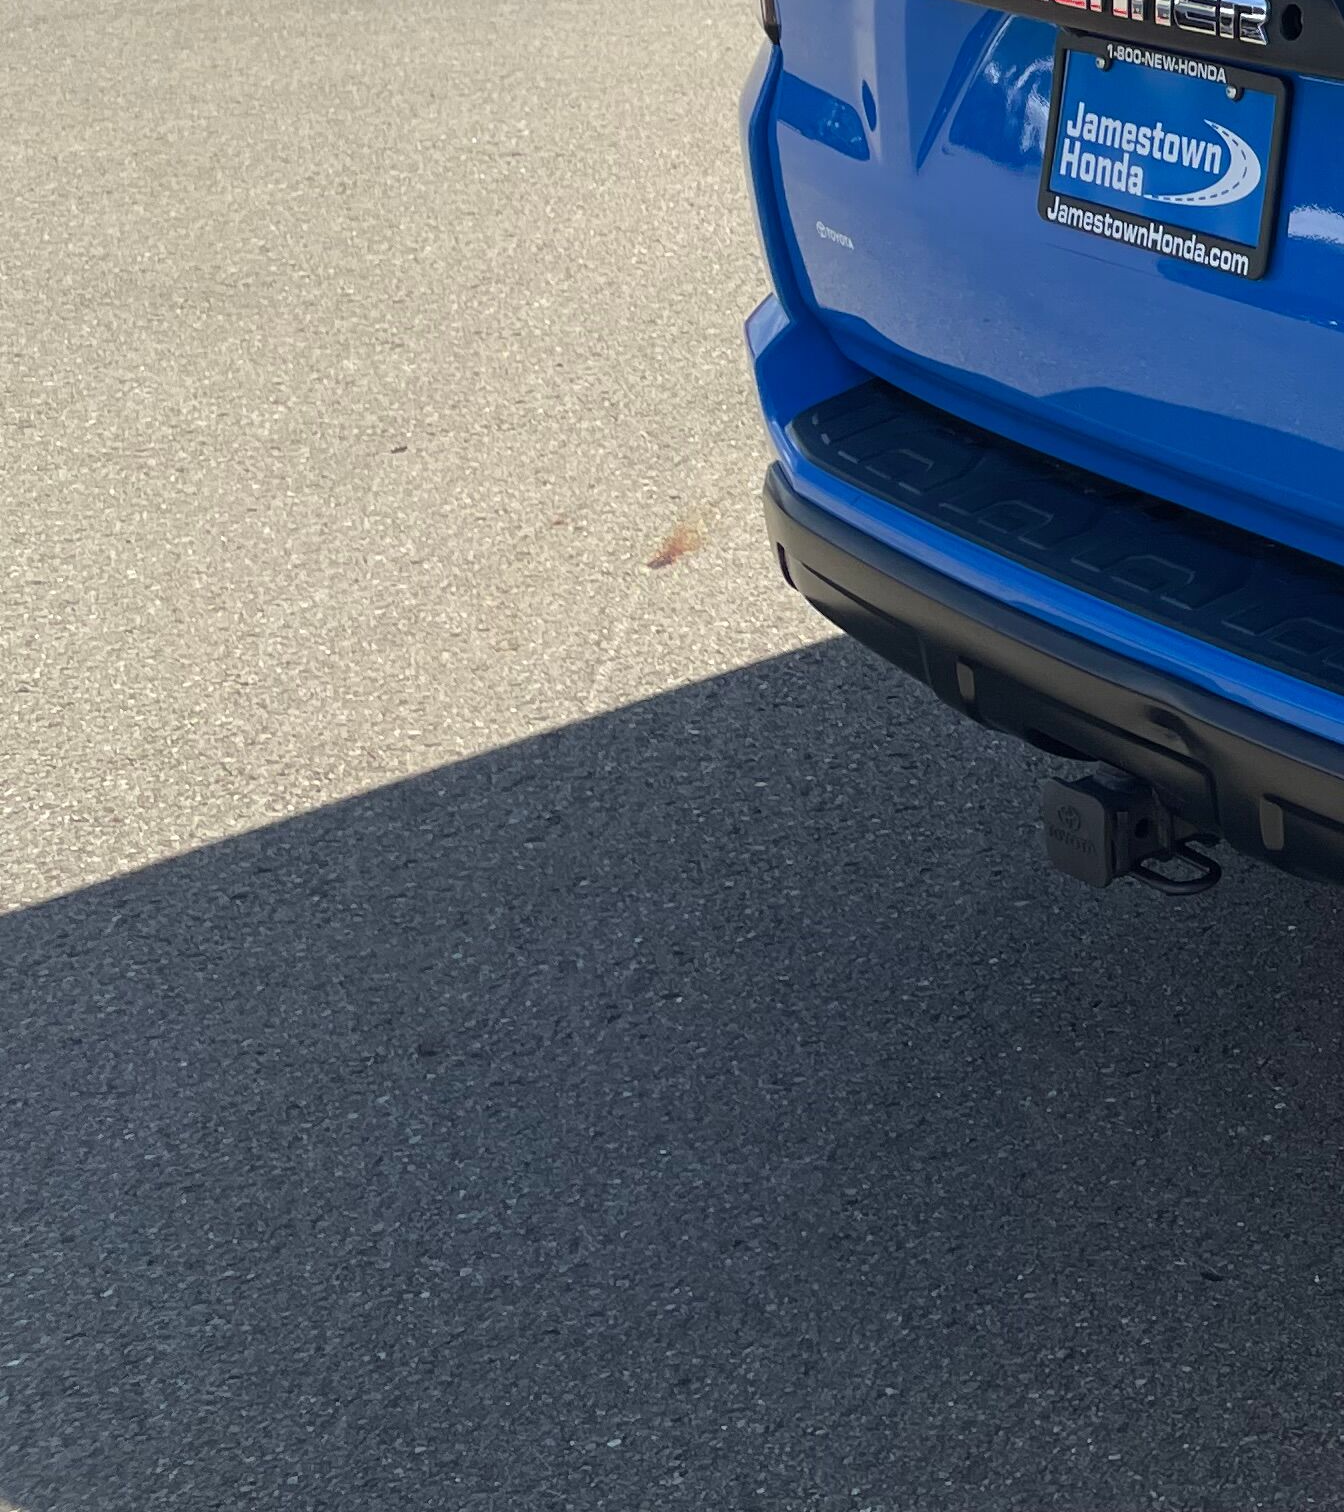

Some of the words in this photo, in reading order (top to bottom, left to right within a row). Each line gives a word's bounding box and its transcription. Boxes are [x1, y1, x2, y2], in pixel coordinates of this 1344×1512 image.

[1059, 138, 1145, 197] Honda
[1066, 101, 1223, 175] Jamestown
[826, 227, 854, 250] TOYOTA
[1047, 196, 1250, 276] JamestownHonda.com
